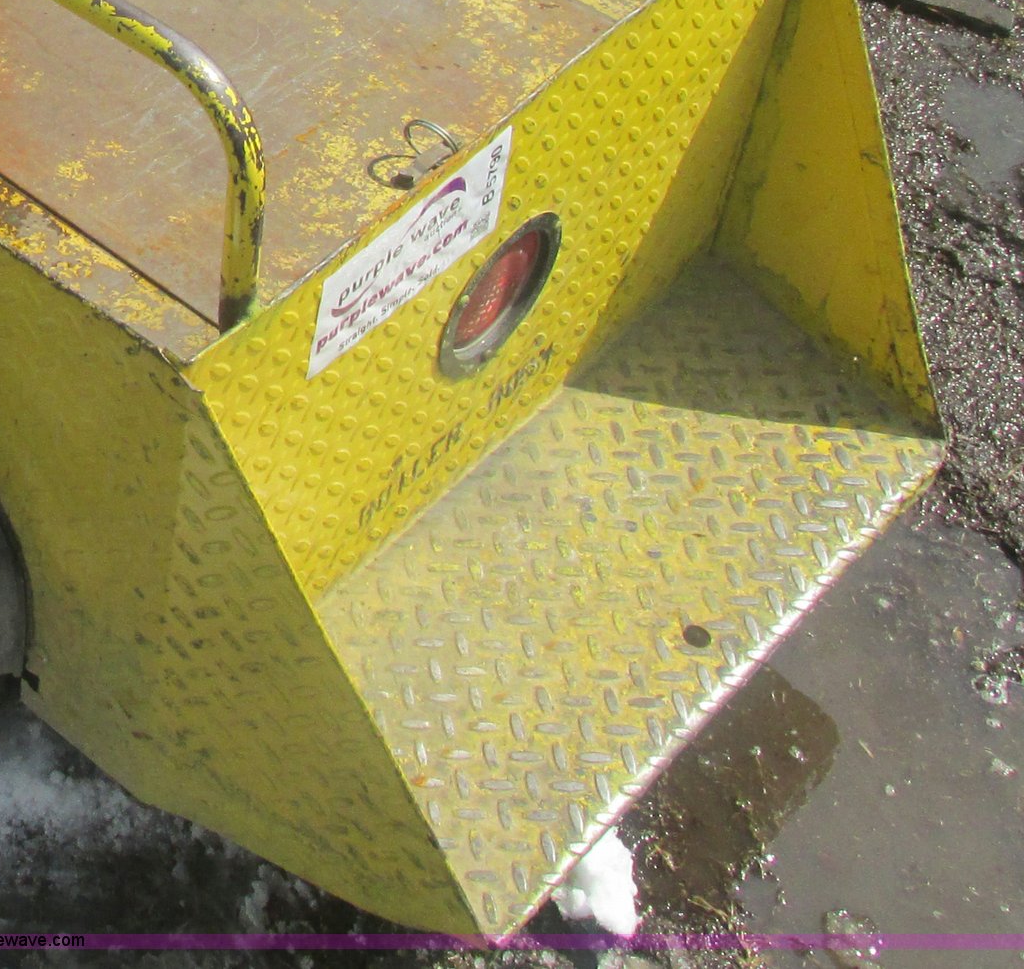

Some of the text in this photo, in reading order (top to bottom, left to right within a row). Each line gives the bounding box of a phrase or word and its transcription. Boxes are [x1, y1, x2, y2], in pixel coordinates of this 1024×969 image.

[316, 219, 469, 355] purplewave.com
[337, 196, 462, 307] purple wave
[338, 316, 379, 352] Straight.
